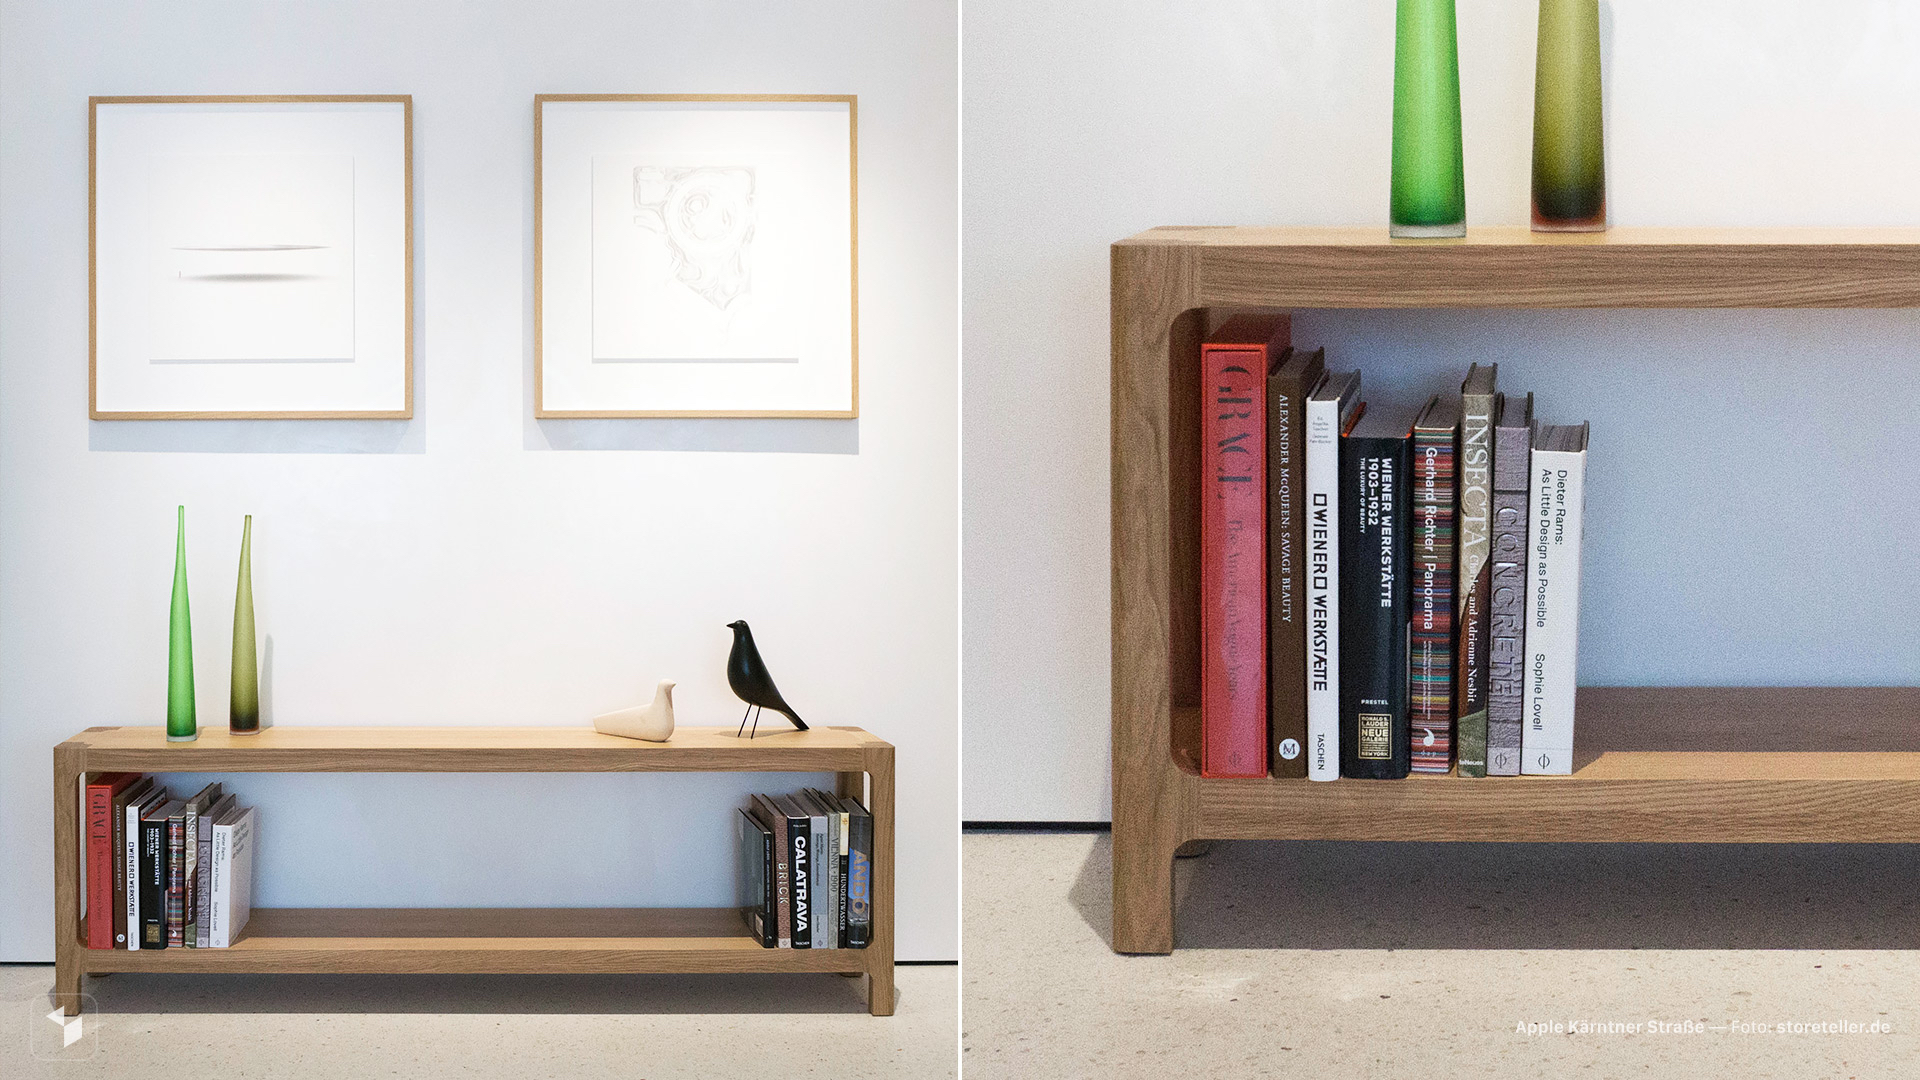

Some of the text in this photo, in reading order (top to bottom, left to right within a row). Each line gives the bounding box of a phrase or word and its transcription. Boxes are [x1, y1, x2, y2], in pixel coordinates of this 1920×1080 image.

[1217, 365, 1253, 500] GRACE
[1279, 394, 1289, 464] ALEXANDER
[1425, 447, 1438, 500] Gerhard
[1463, 413, 1489, 549] INSECTA
[1359, 498, 1366, 506] OF
[1424, 505, 1437, 551] Richter
[1554, 469, 1568, 545] Dieter Rams:
[1280, 532, 1291, 574] SAVAGE
[1380, 457, 1395, 607] WIENER WERKSTÄTTE
[1281, 577, 1292, 623] BEAUTY
[1423, 563, 1436, 629] Panorama
[1468, 597, 1478, 615] and
[1490, 506, 1519, 695] CONCRETE
[1532, 469, 1551, 731] As Little Design as Possible Sophie Lovell
[1467, 618, 1478, 665] Adrienne
[1467, 668, 1478, 703] Nesbit
[1316, 733, 1325, 770] TASCHEN
[1361, 729, 1389, 737] NEUE
[92, 793, 107, 845] GRACE
[186, 811, 196, 863] INSECTA
[831, 837, 839, 869] VIENNA
[778, 863, 789, 904] BRICK
[795, 836, 808, 932] CALATRAVA
[852, 849, 868, 914] ANDO
